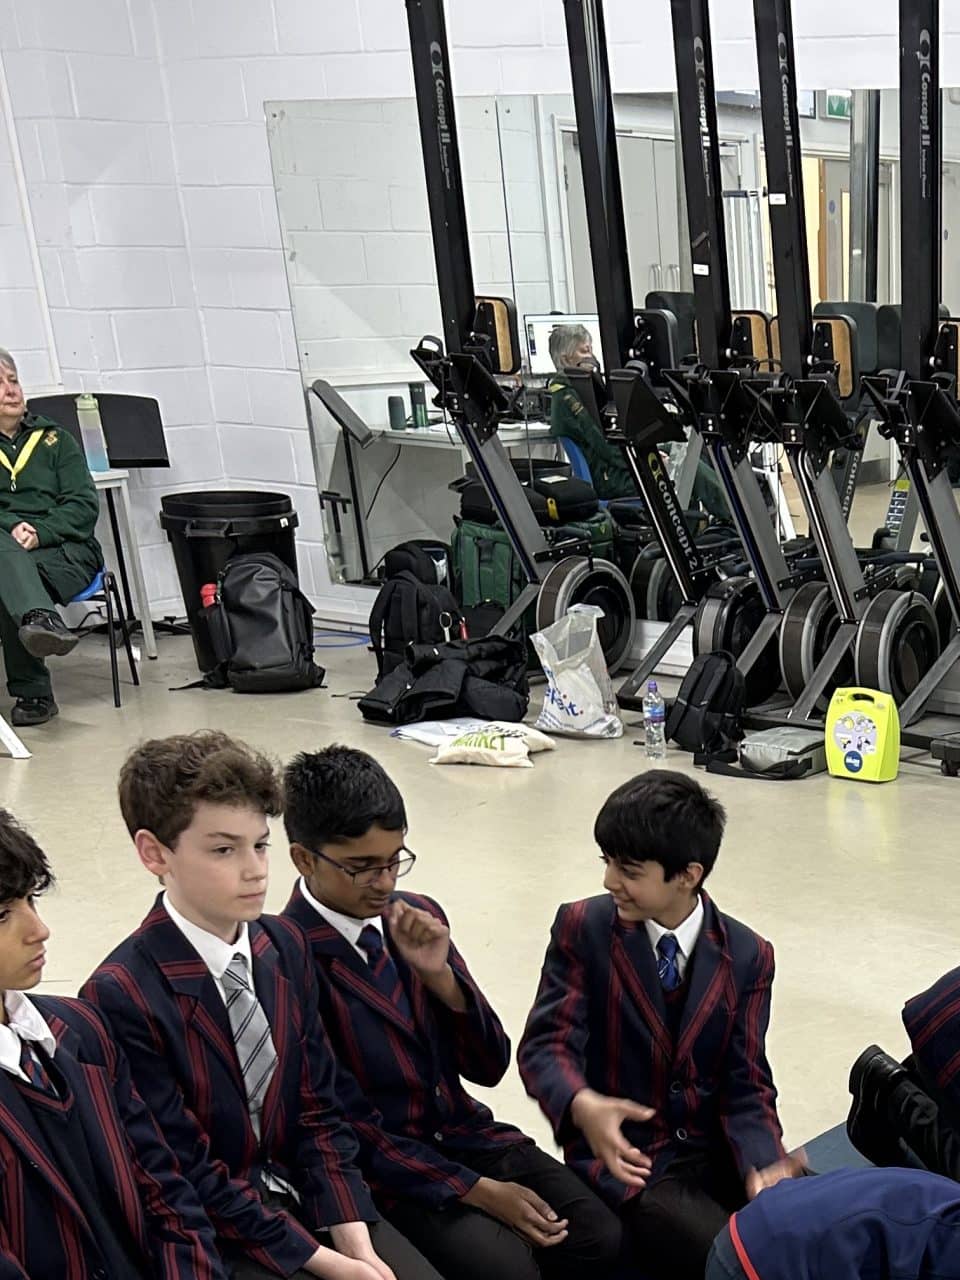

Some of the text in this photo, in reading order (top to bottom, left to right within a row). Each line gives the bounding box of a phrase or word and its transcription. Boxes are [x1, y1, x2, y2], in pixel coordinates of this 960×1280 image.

[435, 78, 449, 130] Concept
[699, 77, 709, 133] Concept
[781, 74, 791, 132] Concept
[920, 72, 931, 130] Concept
